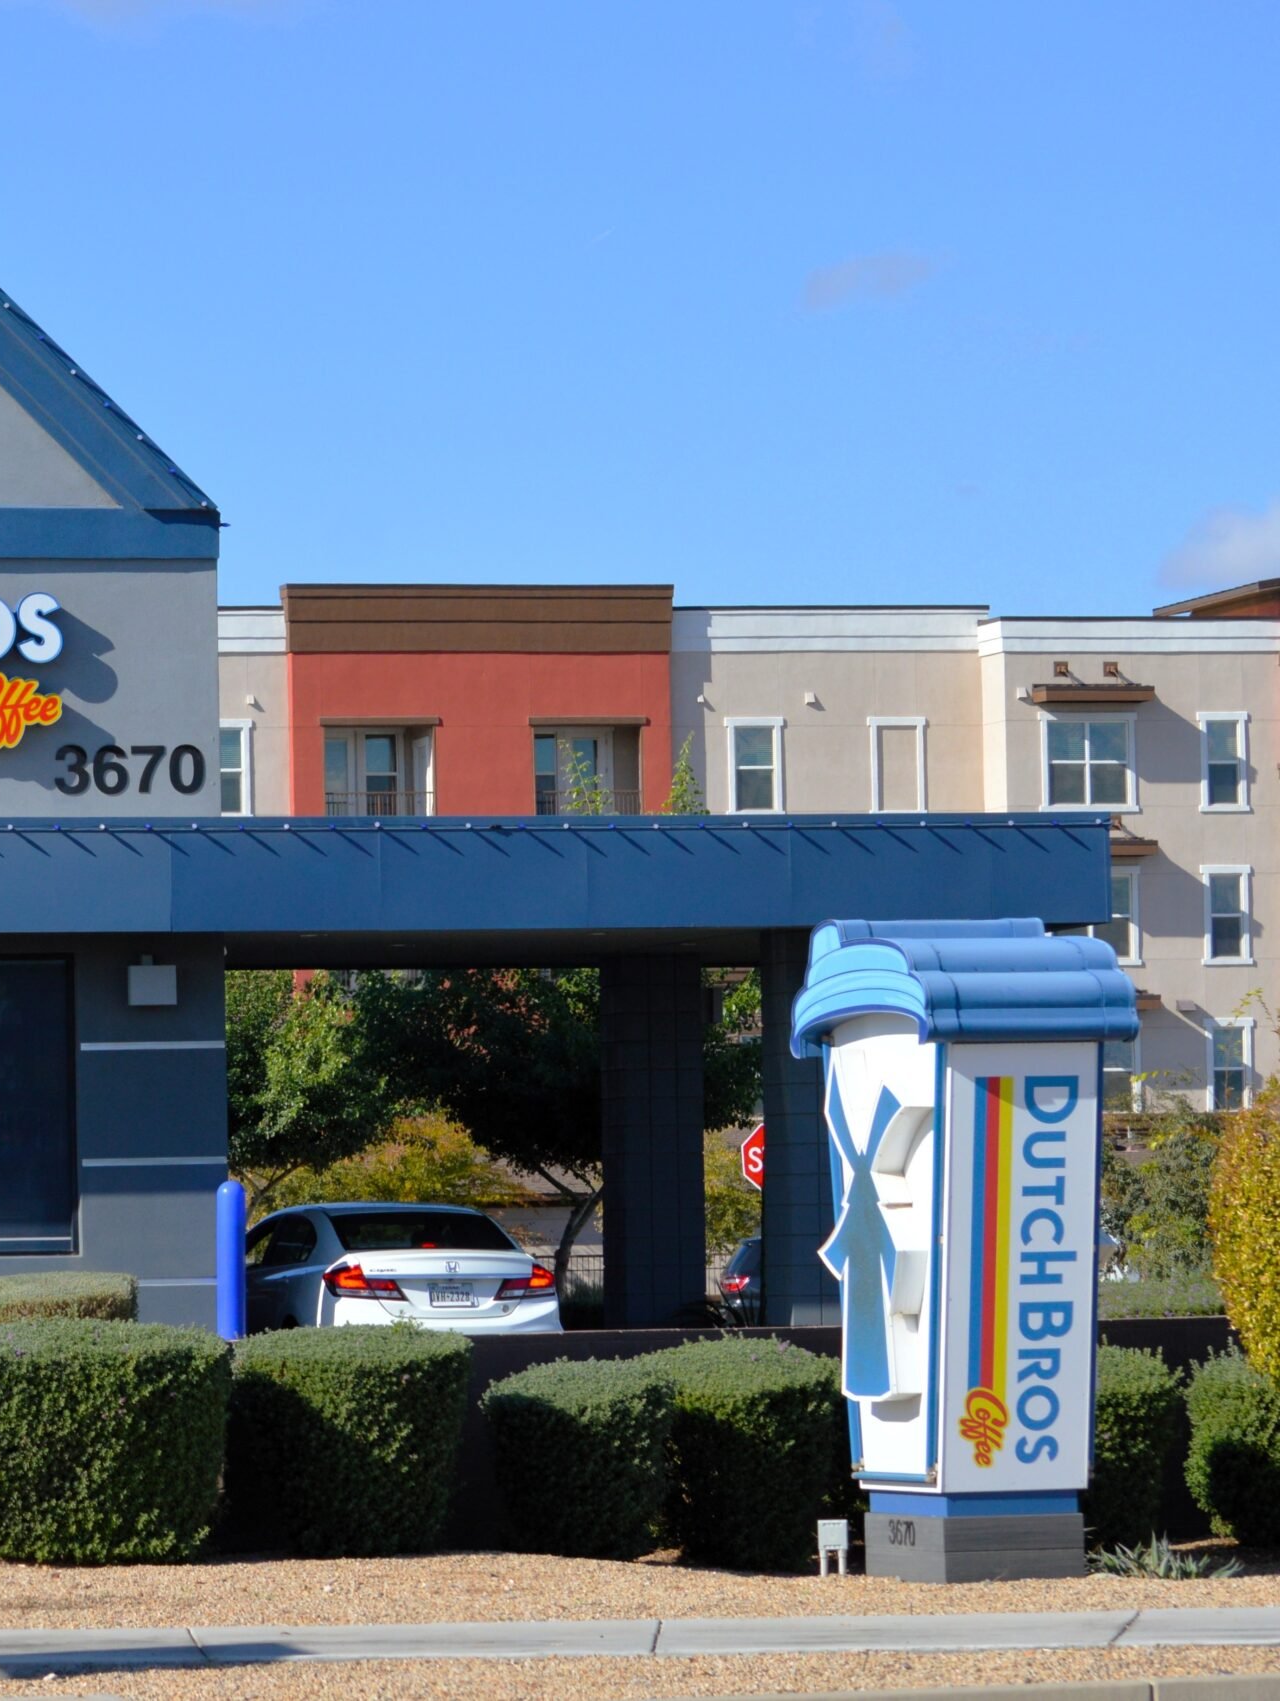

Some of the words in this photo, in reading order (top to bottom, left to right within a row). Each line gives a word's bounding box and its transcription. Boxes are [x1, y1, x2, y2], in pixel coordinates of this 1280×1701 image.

[53, 745, 206, 795] 3670
[1019, 1075, 1079, 1285] DUTCH
[1016, 1302, 1074, 1464] BROS
[961, 1387, 1008, 1467] Coffee
[888, 1519, 916, 1546] 3670
